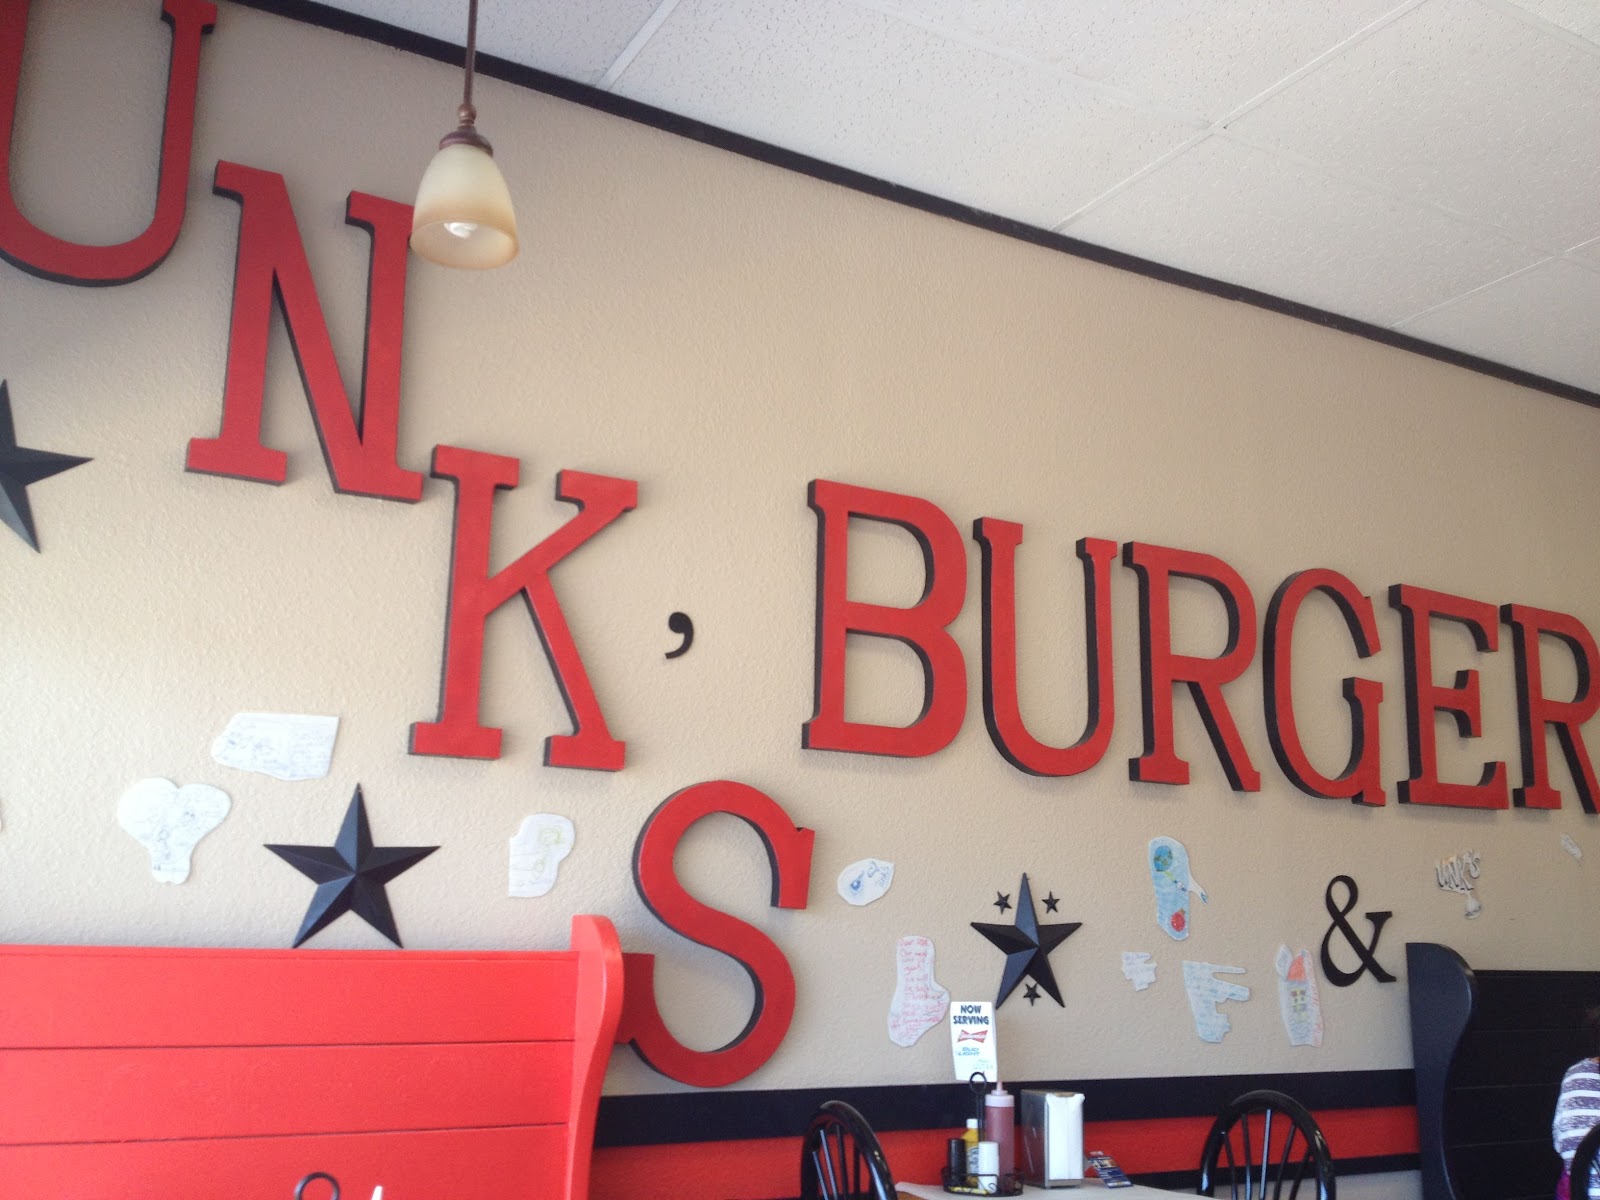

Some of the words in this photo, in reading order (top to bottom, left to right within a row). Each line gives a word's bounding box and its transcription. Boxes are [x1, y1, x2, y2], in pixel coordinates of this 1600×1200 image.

[802, 479, 1600, 815] BURGER
[1321, 875, 1397, 987] &
[953, 1015, 990, 1025] SERVING
[960, 1004, 982, 1014] NOW
